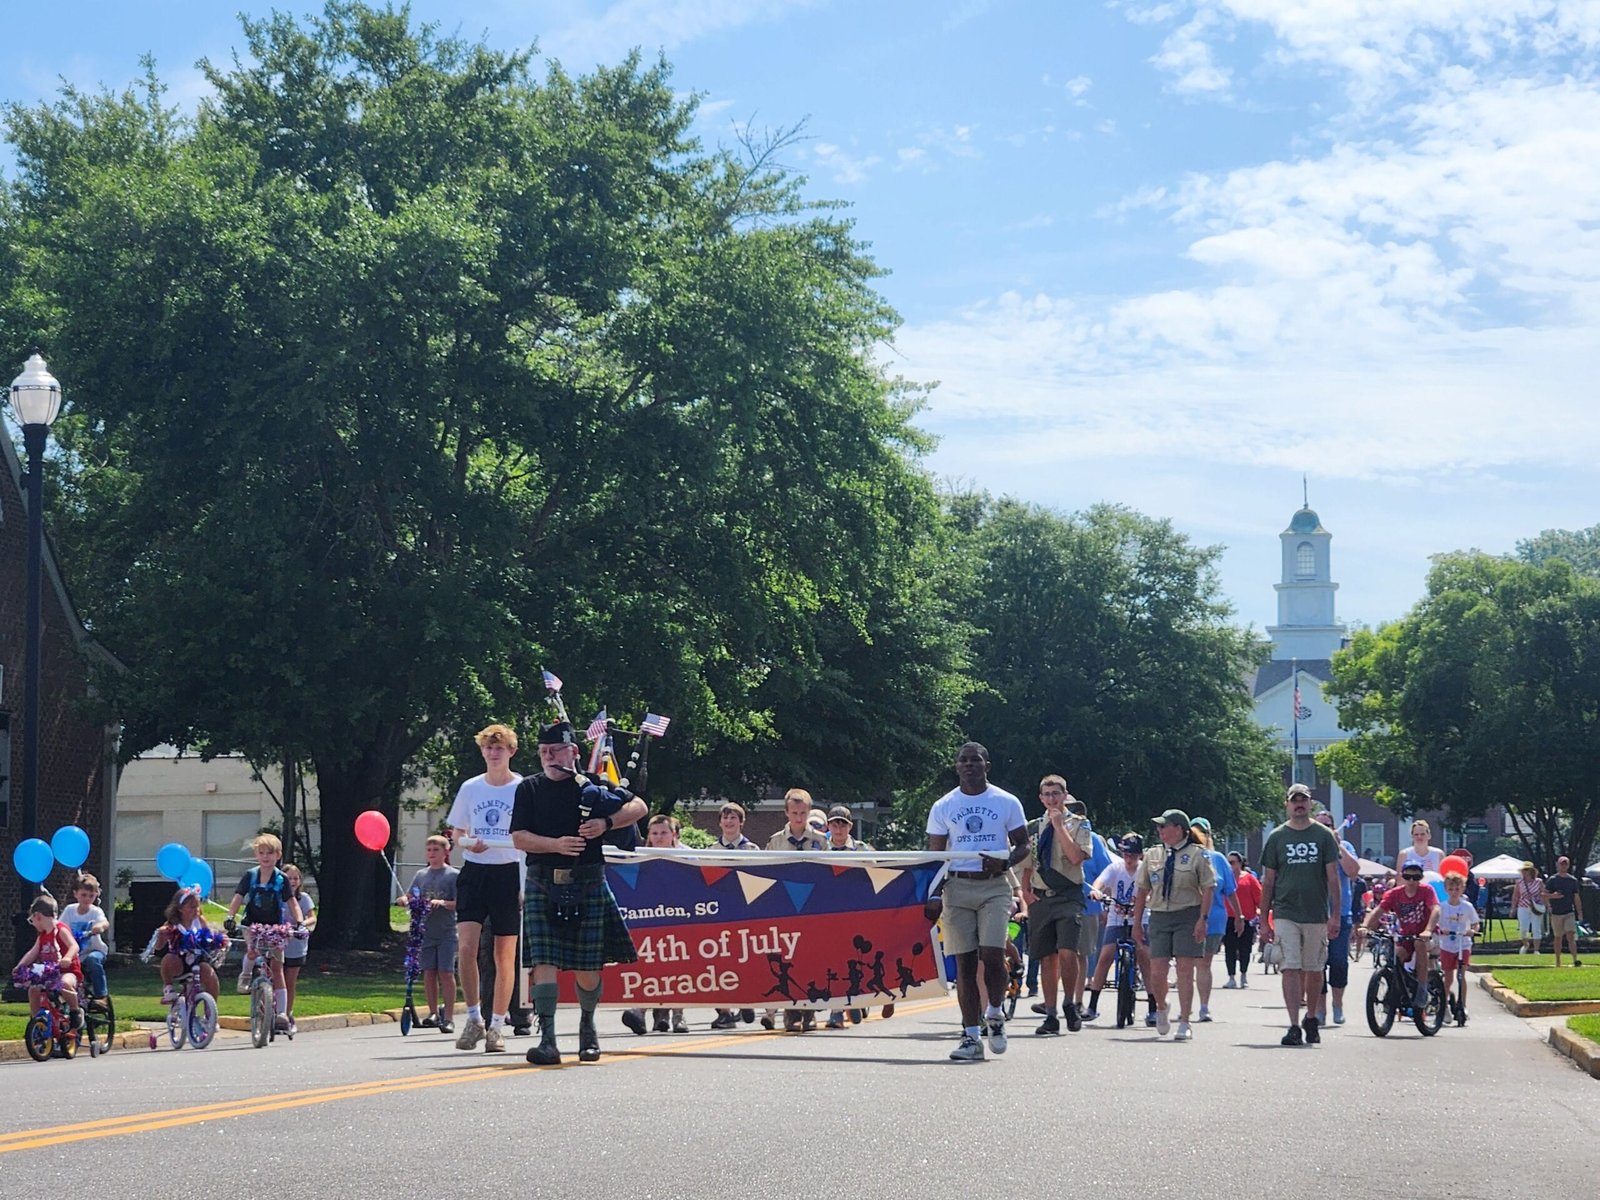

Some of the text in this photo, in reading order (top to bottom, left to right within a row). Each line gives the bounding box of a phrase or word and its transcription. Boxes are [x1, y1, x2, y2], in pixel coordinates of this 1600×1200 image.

[951, 807, 998, 824] PALMETTO
[973, 834, 996, 842] STATE
[1286, 843, 1318, 857] 303
[618, 901, 719, 920] Camden, SC
[637, 926, 801, 964] 4th of July
[620, 965, 740, 999] Parade
